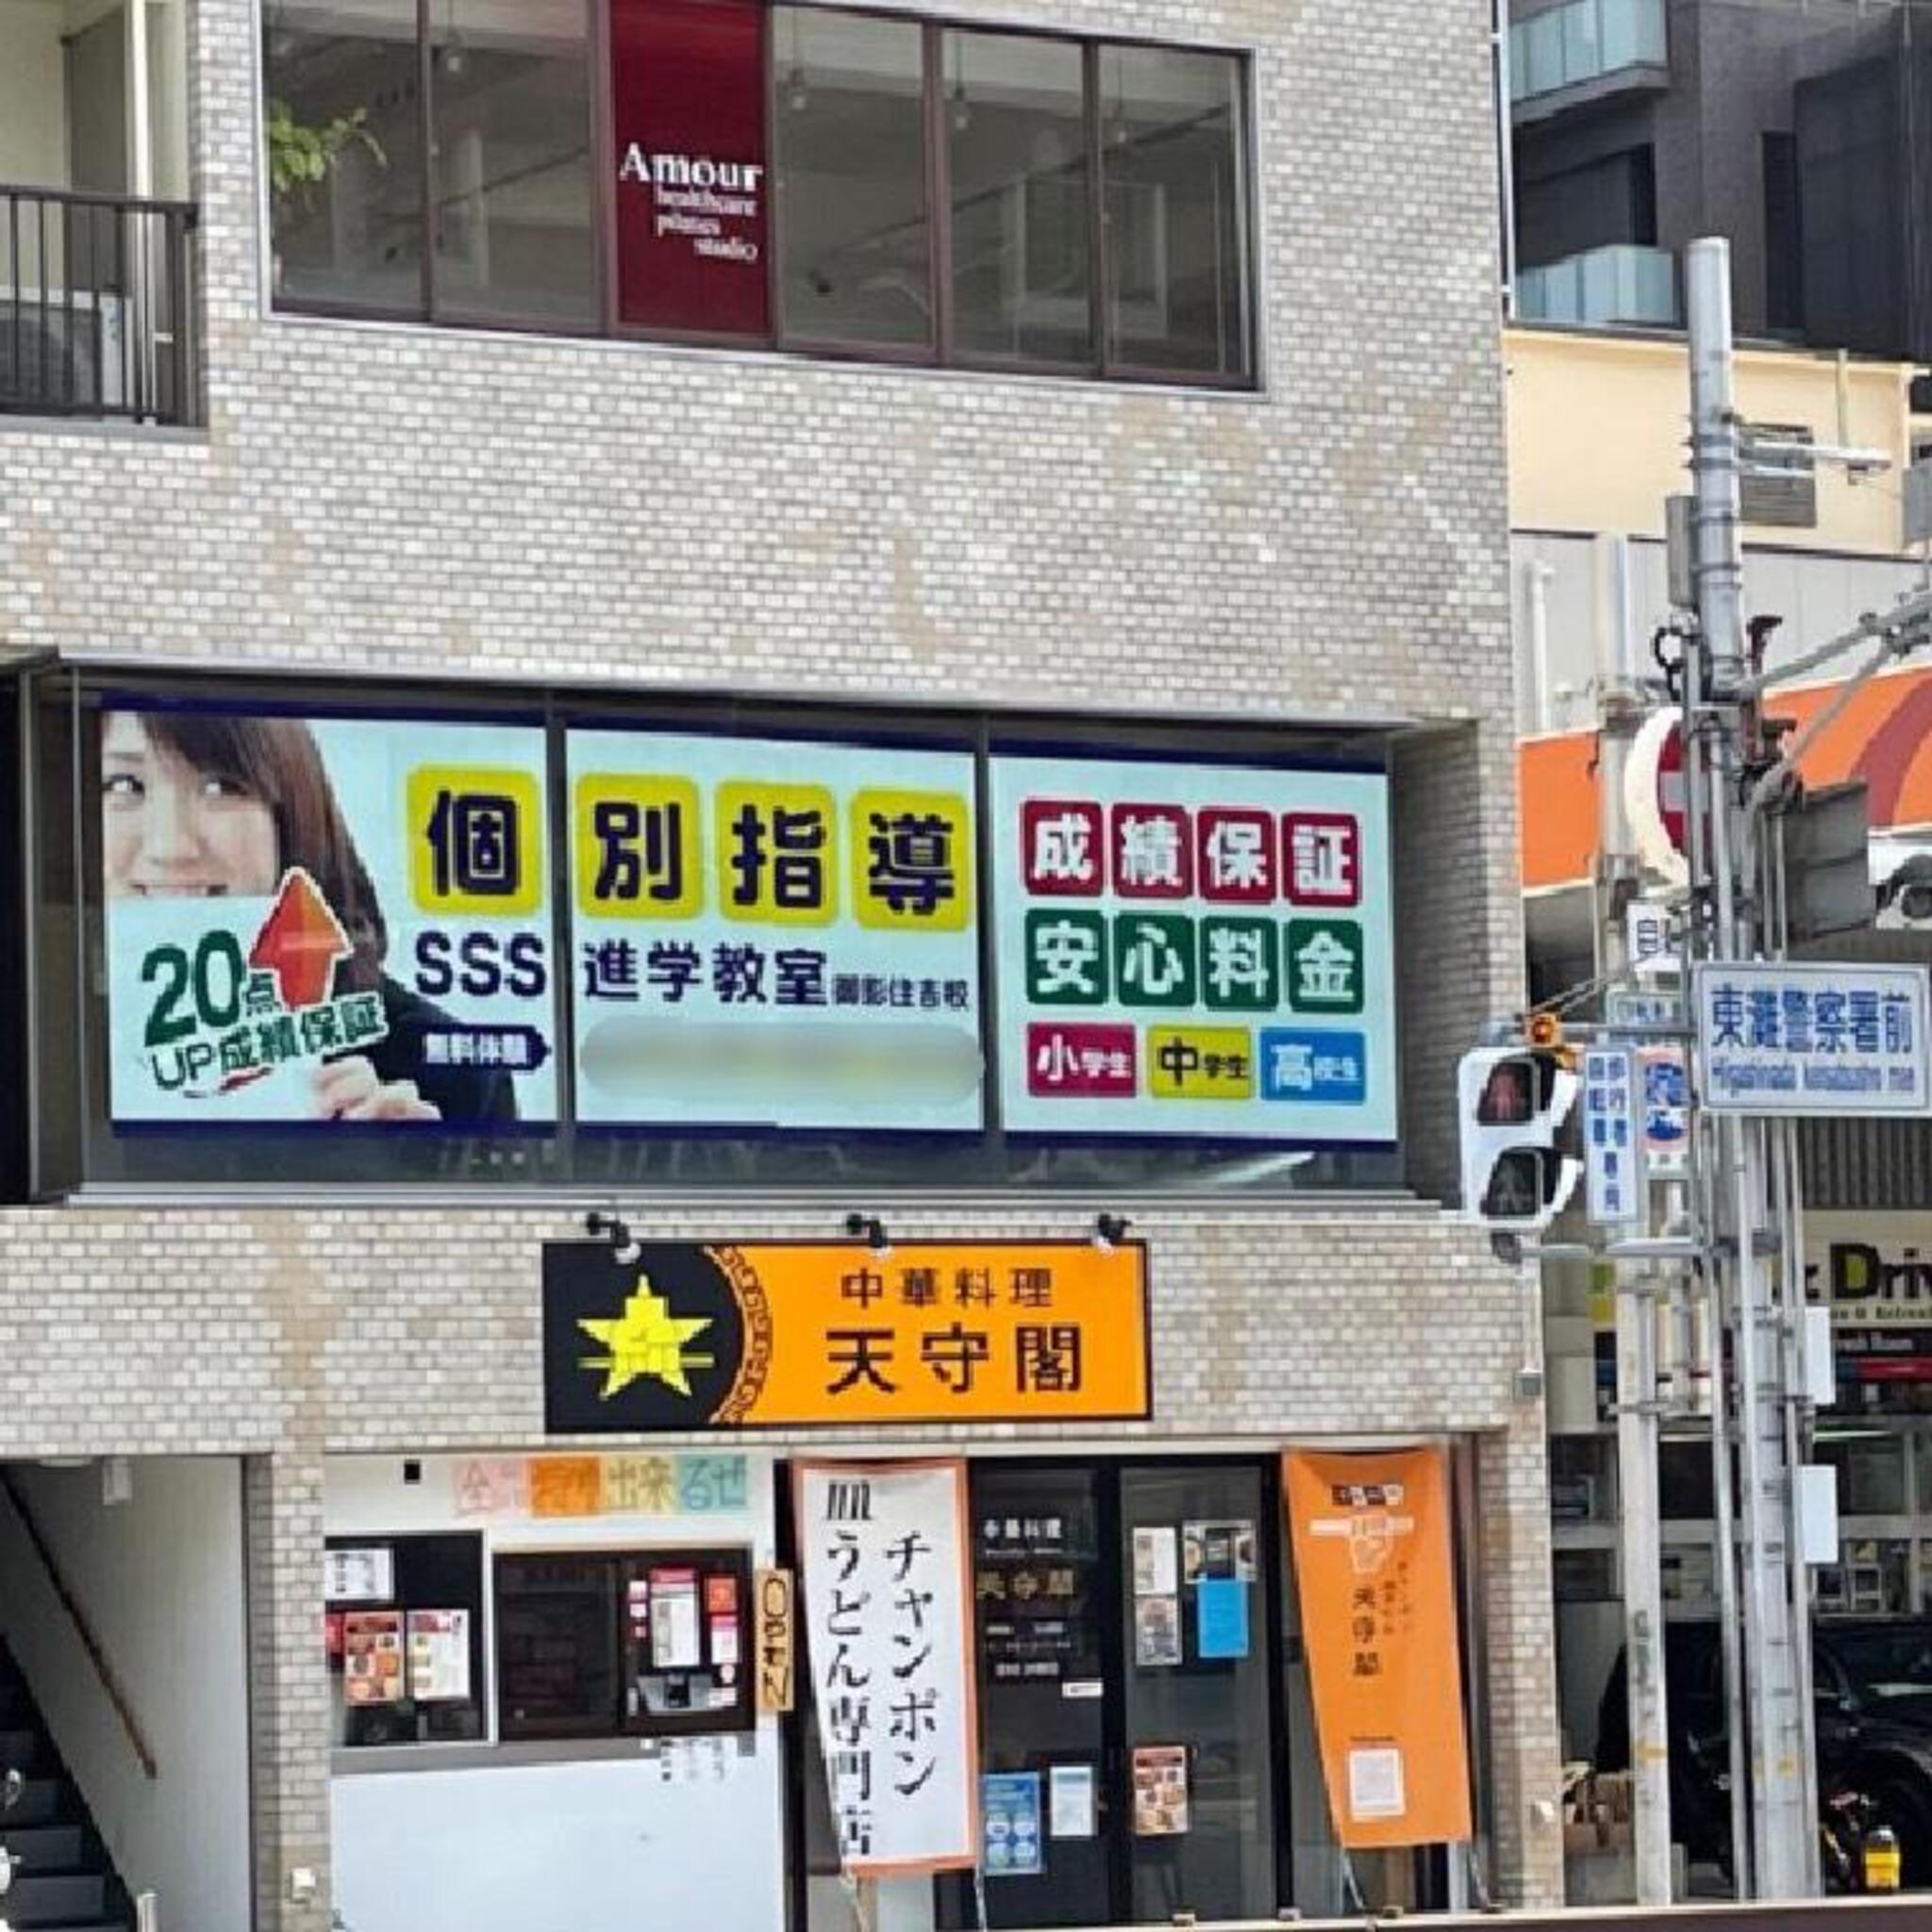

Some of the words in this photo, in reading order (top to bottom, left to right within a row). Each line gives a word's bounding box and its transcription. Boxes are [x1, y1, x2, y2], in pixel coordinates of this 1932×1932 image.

[619, 142, 763, 192] Amour
[1034, 813, 1352, 895] 成績保証
[1036, 921, 1355, 1001] 安心料金
[1711, 983, 1912, 1053] 東灘警察署前
[1038, 1034, 1131, 1082] 小学生
[1159, 1038, 1249, 1087] 中学生
[840, 1267, 1053, 1309] 中華料理
[824, 1322, 1082, 1394] 天守閣
[886, 1530, 939, 1796] チャンポン
